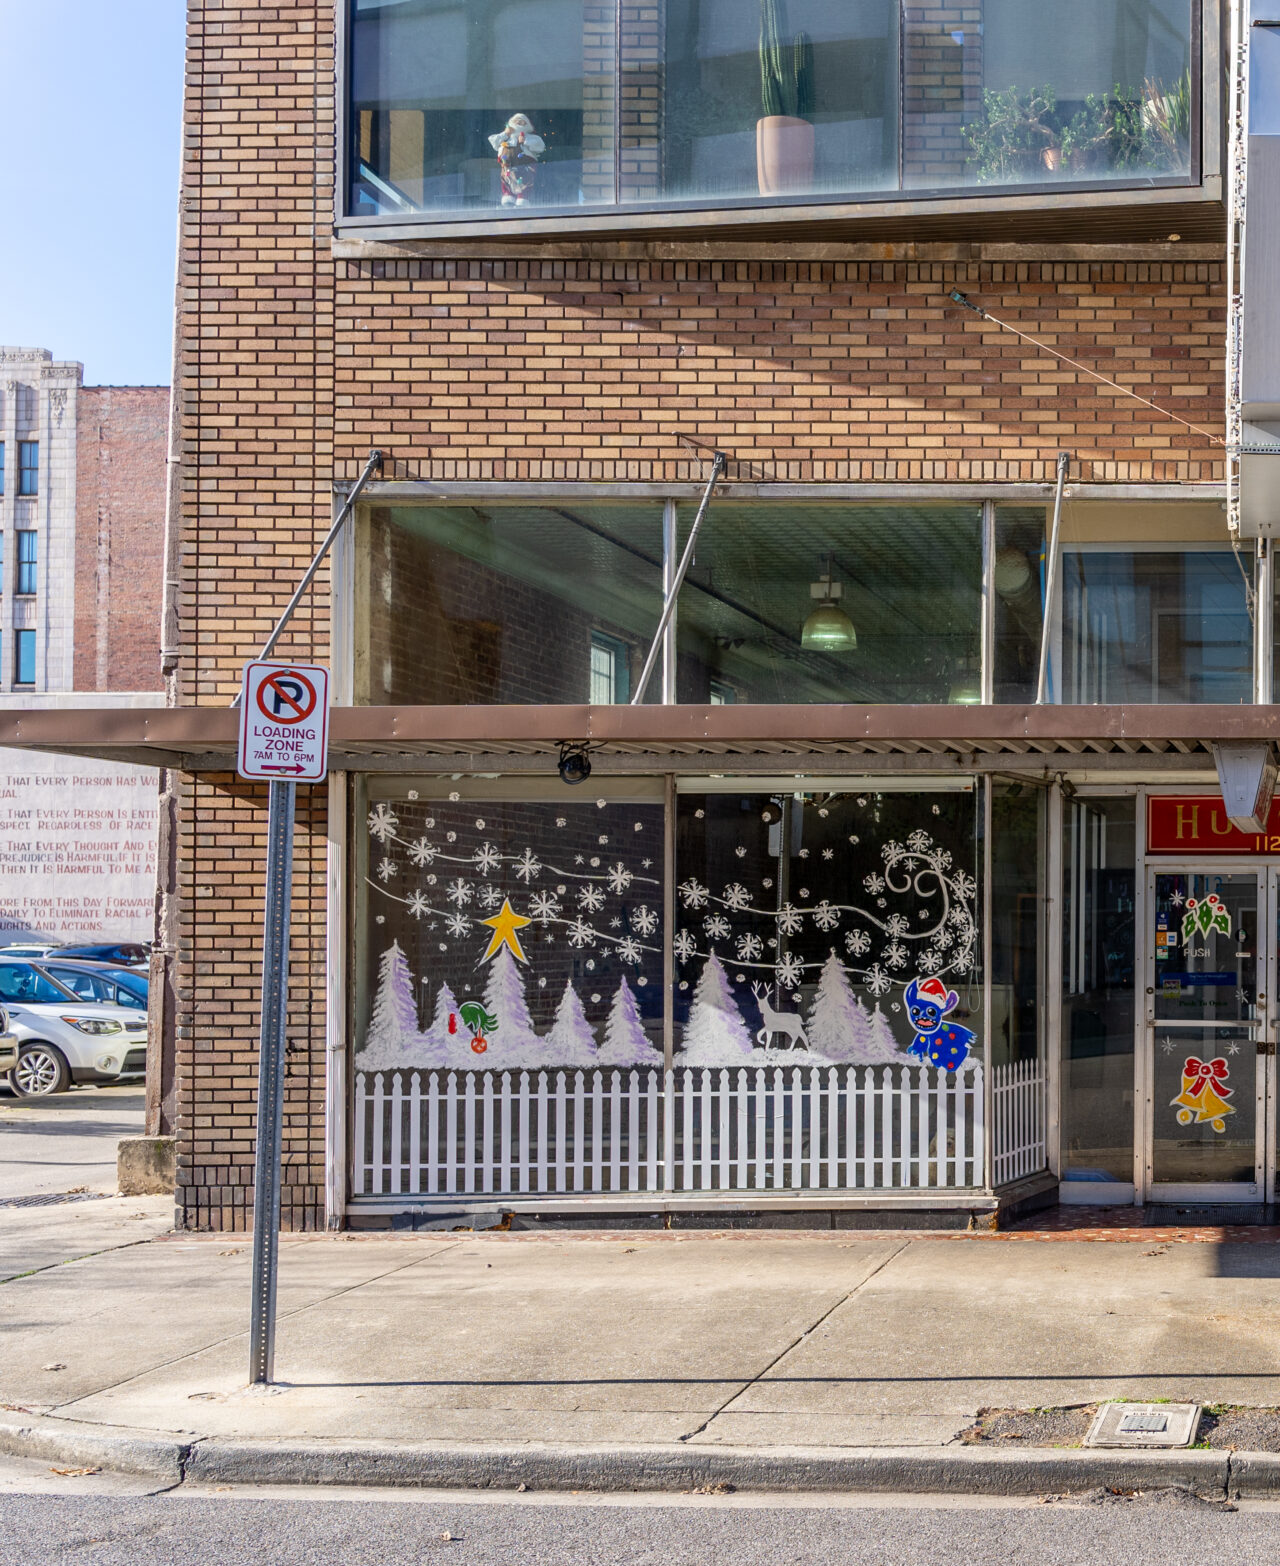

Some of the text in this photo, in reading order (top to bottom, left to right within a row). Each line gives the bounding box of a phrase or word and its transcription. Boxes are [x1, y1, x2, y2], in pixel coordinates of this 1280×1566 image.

[253, 725, 316, 740] LOADING
[265, 739, 304, 752] ZONE
[253, 750, 315, 763] 7AM TO 6PM
[7, 776, 31, 786] THAT
[36, 776, 69, 786] EVERY
[72, 776, 113, 786] PERSON
[116, 776, 137, 786] HAS
[8, 808, 33, 819] THAT
[36, 808, 70, 819] EVERY
[74, 808, 114, 819] PERSON
[117, 808, 128, 819] IS
[38, 820, 102, 830] REGARDLESS
[109, 820, 122, 830] OF
[126, 820, 153, 830] RACE
[7, 840, 32, 851] THAT
[36, 841, 70, 851] EVERY
[73, 840, 119, 851] THOUGHT
[123, 840, 144, 851] AND
[1, 864, 26, 874] THEN
[30, 864, 39, 874] IT
[43, 864, 53, 874] IS
[56, 864, 105, 874] HARMFUL
[108, 864, 122, 874] TO
[125, 864, 141, 874] ME
[23, 897, 53, 907] FROM
[56, 897, 79, 907] THIS
[83, 897, 103, 907] DAY
[0, 908, 28, 918] DAILY
[33, 908, 46, 918] TO
[49, 908, 101, 918] ELIMINATE
[105, 908, 141, 918] RACIAL
[35, 921, 56, 931] AND
[1183, 948, 1210, 957] PUSH
